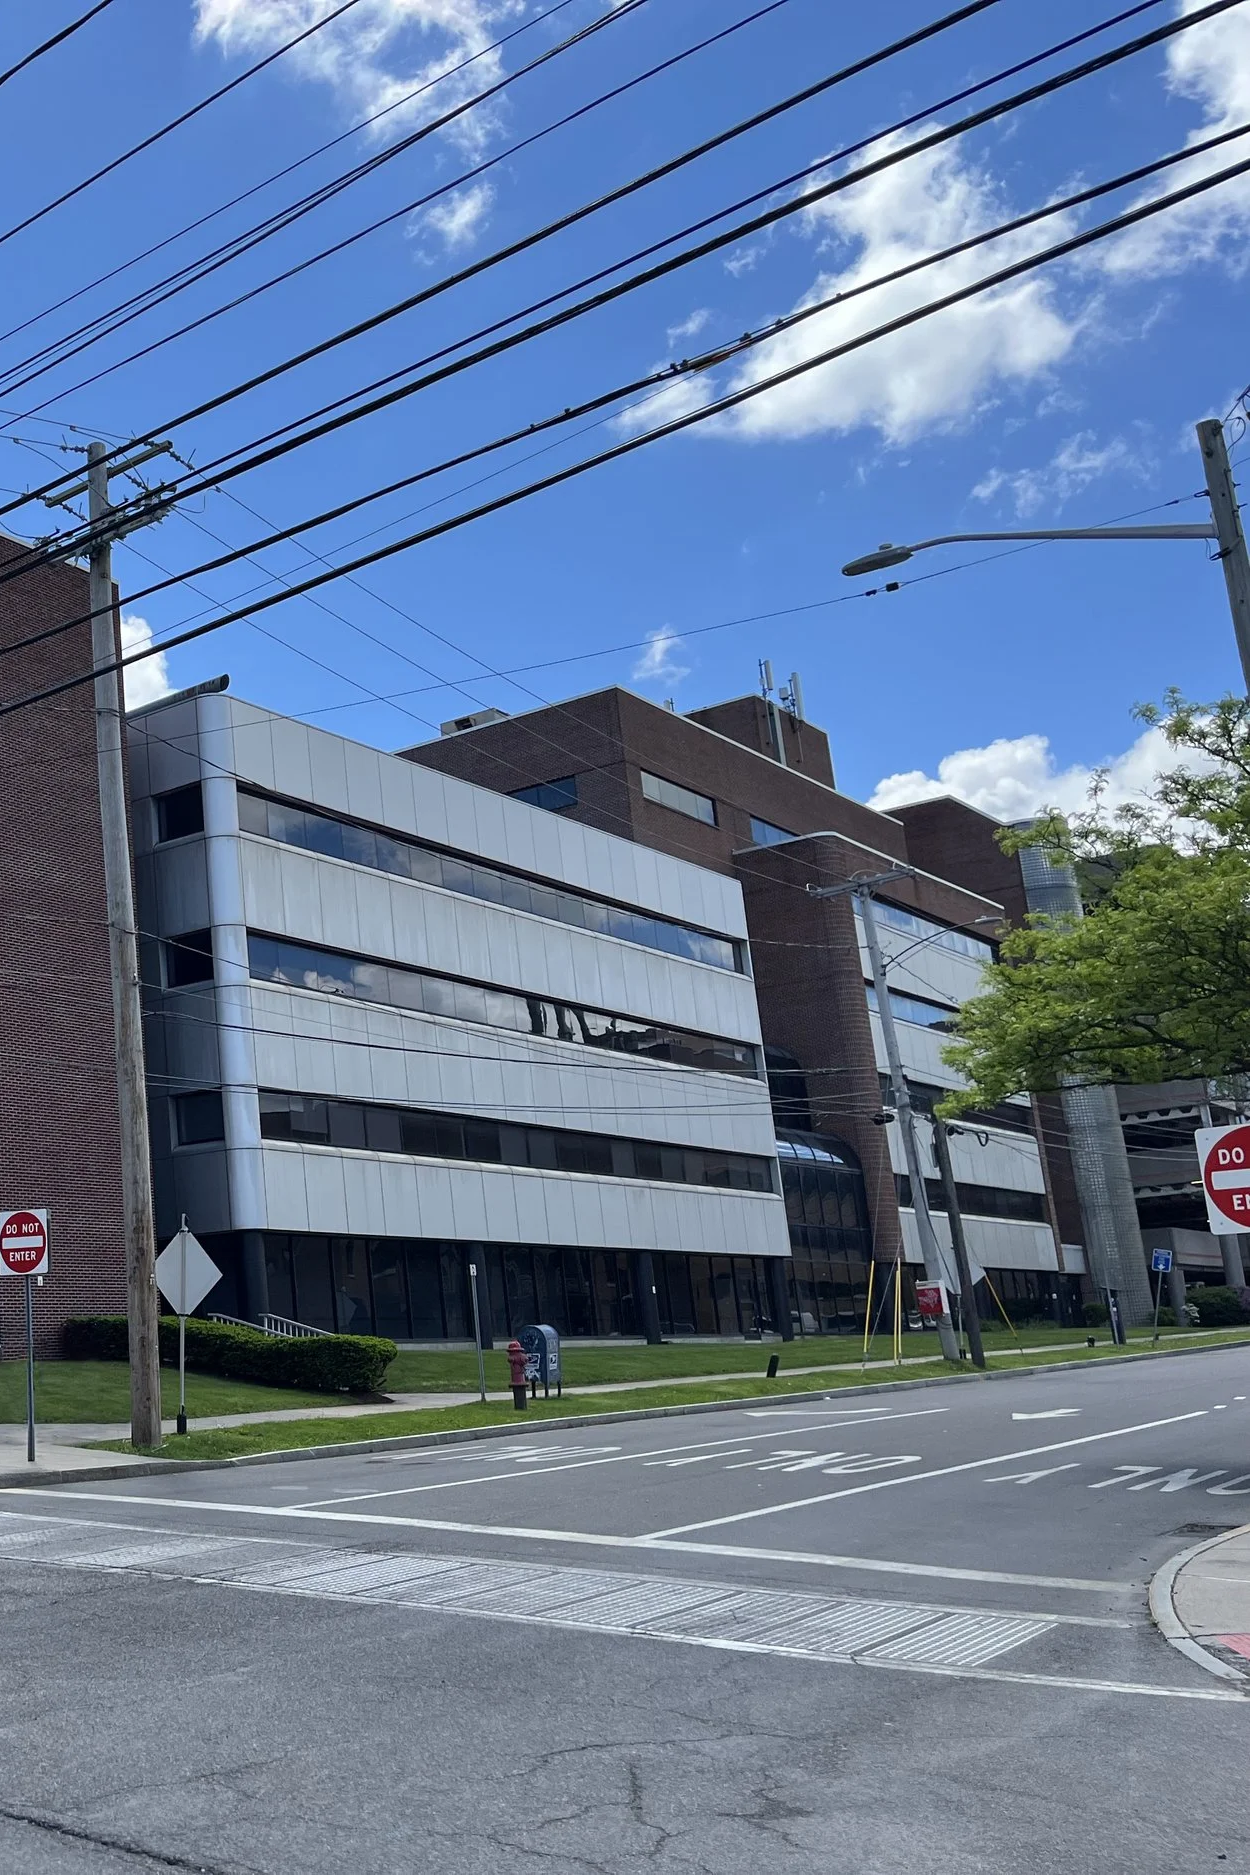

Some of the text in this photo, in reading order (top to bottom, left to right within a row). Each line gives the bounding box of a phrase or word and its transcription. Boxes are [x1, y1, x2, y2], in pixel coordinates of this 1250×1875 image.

[1217, 1147, 1245, 1166] DO
[6, 1222, 40, 1235] DO NOT
[9, 1250, 37, 1262] ENTER
[642, 1448, 922, 1474] ONLY
